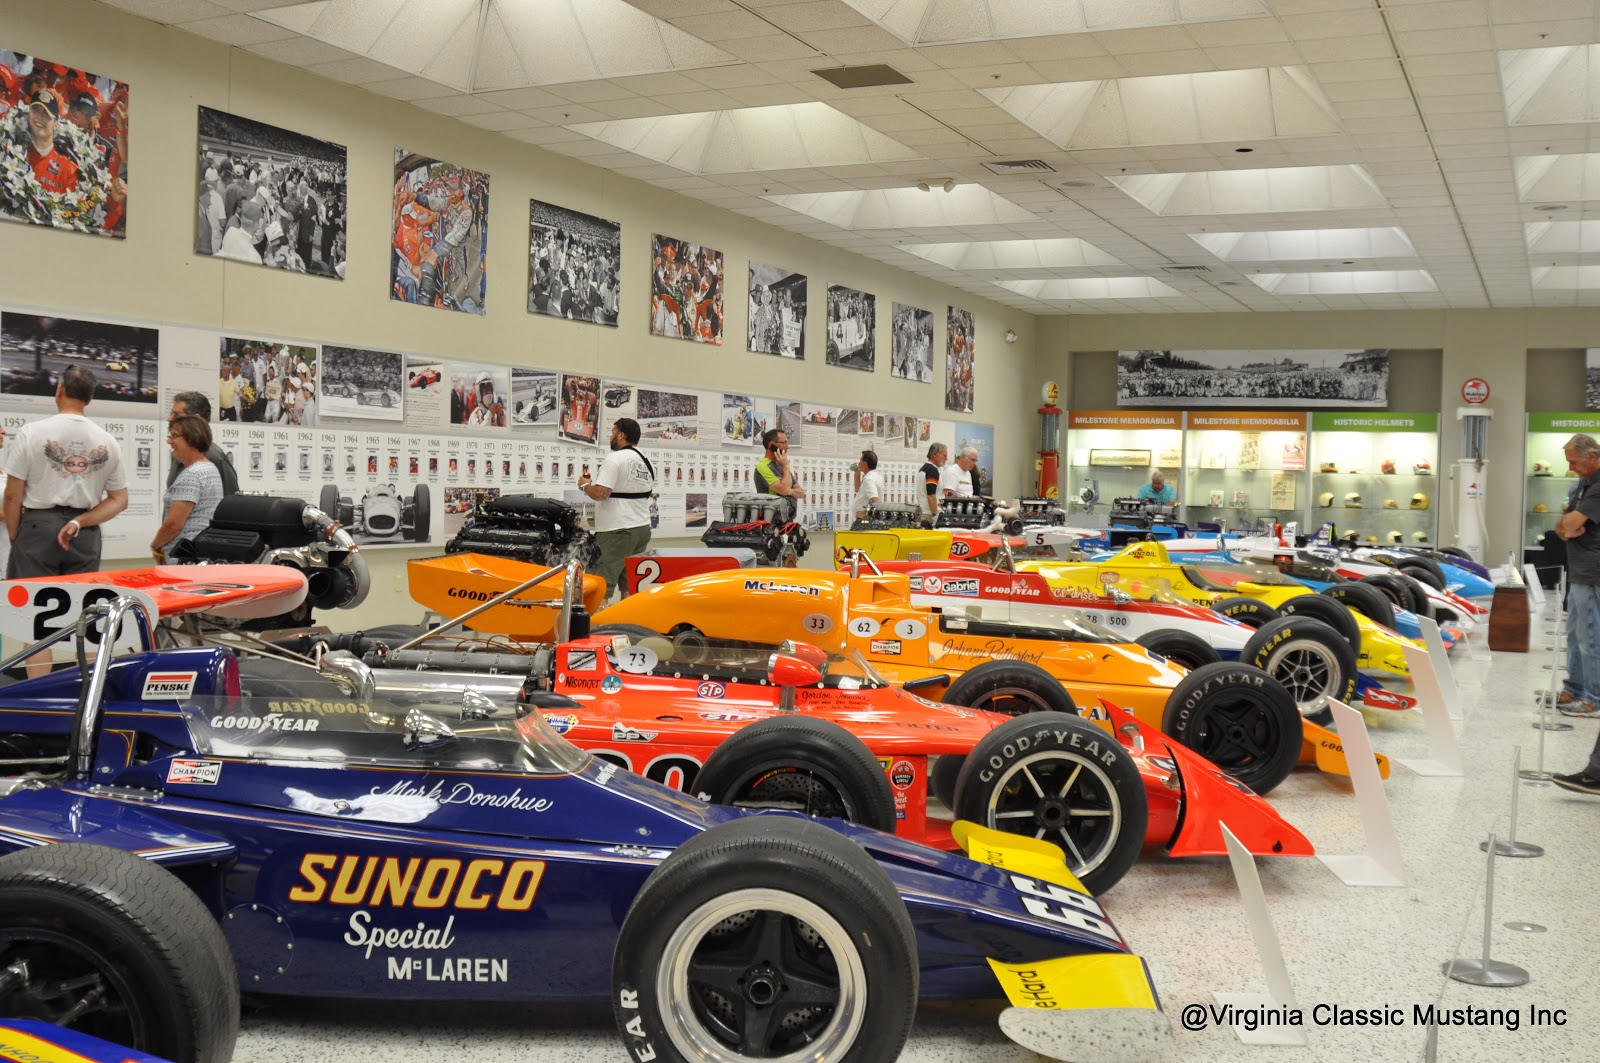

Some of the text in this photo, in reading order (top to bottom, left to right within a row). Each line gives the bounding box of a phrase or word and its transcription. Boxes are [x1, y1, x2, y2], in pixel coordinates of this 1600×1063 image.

[1075, 416, 1175, 425] MILESTONE MEMORABILIA
[1241, 418, 1299, 426] MEMORABILIA
[1334, 418, 1414, 427] HISTORIC HELMETS
[1552, 419, 1594, 428] HISTORIC
[104, 423, 124, 433] 1955
[135, 424, 154, 434] 1956
[222, 430, 238, 438] 1959
[248, 430, 264, 440] 1960
[274, 432, 288, 440] 1961
[298, 432, 313, 442] 1962
[321, 434, 336, 442] 1963
[344, 434, 358, 444] 1964
[366, 436, 380, 445] 1965
[387, 437, 401, 446] 1966
[408, 438, 421, 446] 1967
[428, 438, 440, 447] 1968
[448, 440, 460, 448] 1969
[466, 440, 478, 449] 1970
[484, 442, 495, 450] 1971
[518, 444, 529, 452] 1973
[1036, 533, 1044, 545] 5
[491, 542, 518, 551] Indy
[951, 541, 968, 556] STP
[636, 559, 663, 593] 2
[744, 580, 819, 596] McLaren
[942, 580, 979, 592] Gabriel
[984, 586, 1040, 597] GOODYEAR
[810, 618, 825, 630] 33
[1110, 616, 1127, 626] 500
[857, 622, 871, 633] 62
[907, 624, 913, 634] 3
[629, 653, 646, 667] 73
[146, 683, 190, 691] PENSKE
[565, 675, 601, 691] Nisonger
[701, 683, 723, 697] STP
[210, 712, 320, 733] GOODYEAR
[978, 729, 1117, 784] GOODYEAR
[173, 768, 216, 776] CHAMPION
[370, 779, 553, 812] Mark Donohue
[289, 852, 546, 911] SUNOCO
[343, 910, 456, 960] Special
[387, 956, 509, 983] McLAREN
